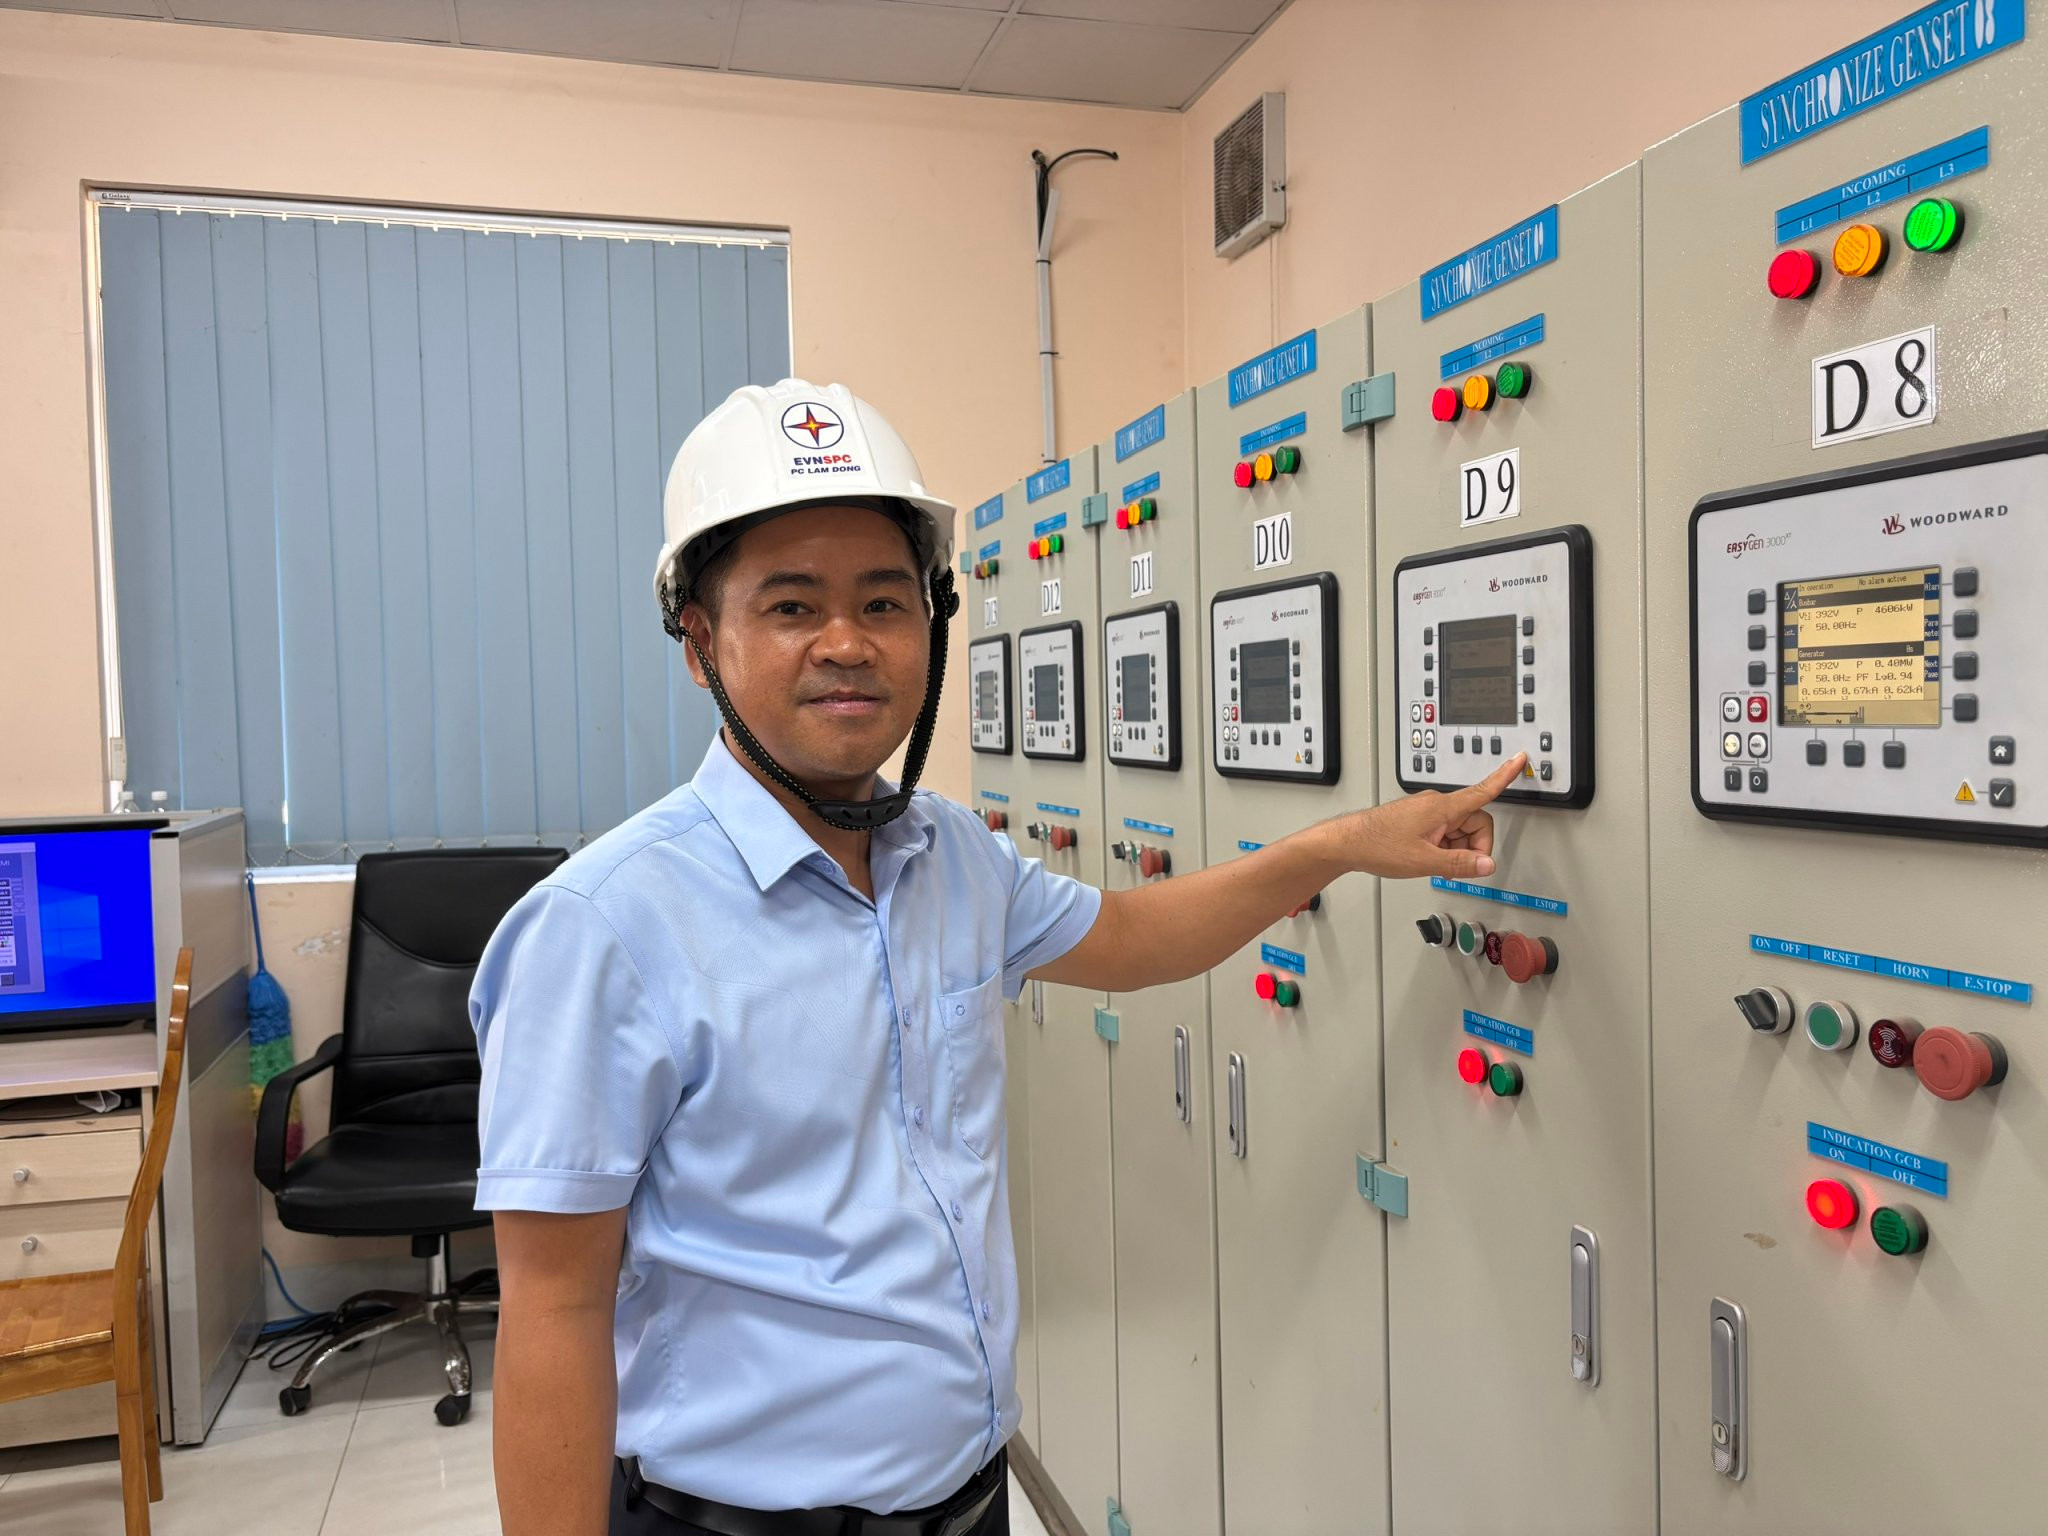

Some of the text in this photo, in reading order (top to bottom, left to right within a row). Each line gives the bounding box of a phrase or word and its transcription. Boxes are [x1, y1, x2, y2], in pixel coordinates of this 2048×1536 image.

[1760, 44, 1885, 149] SYNCHRONIZE
[1890, 1, 1969, 88] GENSET
[1841, 163, 1906, 199] INCOMING
[1801, 163, 1954, 231] L1 L2 L3
[1431, 249, 1492, 311] SYNCHRONIZE
[1494, 228, 1531, 281] GENSET
[1472, 333, 1504, 352] INCOMING
[793, 454, 852, 466] EVNSPC
[832, 465, 861, 473] DONG
[1909, 505, 2008, 528] WOODWARD
[1255, 517, 1290, 565] D10
[1132, 556, 1152, 593] D11
[1501, 574, 1548, 588] WOODWARD
[1043, 582, 1060, 613] D12
[1815, 609, 1840, 619] 392V
[1815, 661, 1839, 670] 392V
[1856, 673, 1868, 681] PF
[1467, 885, 1486, 896] RESET
[1501, 891, 1519, 902] HORN
[1755, 937, 1801, 955] ON OFF
[1823, 949, 1860, 966] RESET
[1893, 962, 1929, 979] HORN
[1964, 976, 2012, 995] E.STOP
[1471, 1013, 1520, 1037] INDICATION GCB
[1506, 1038, 1519, 1048] OFF
[1823, 1128, 1921, 1169] INDICATION GCB
[1828, 1147, 1917, 1185] ON OFF
